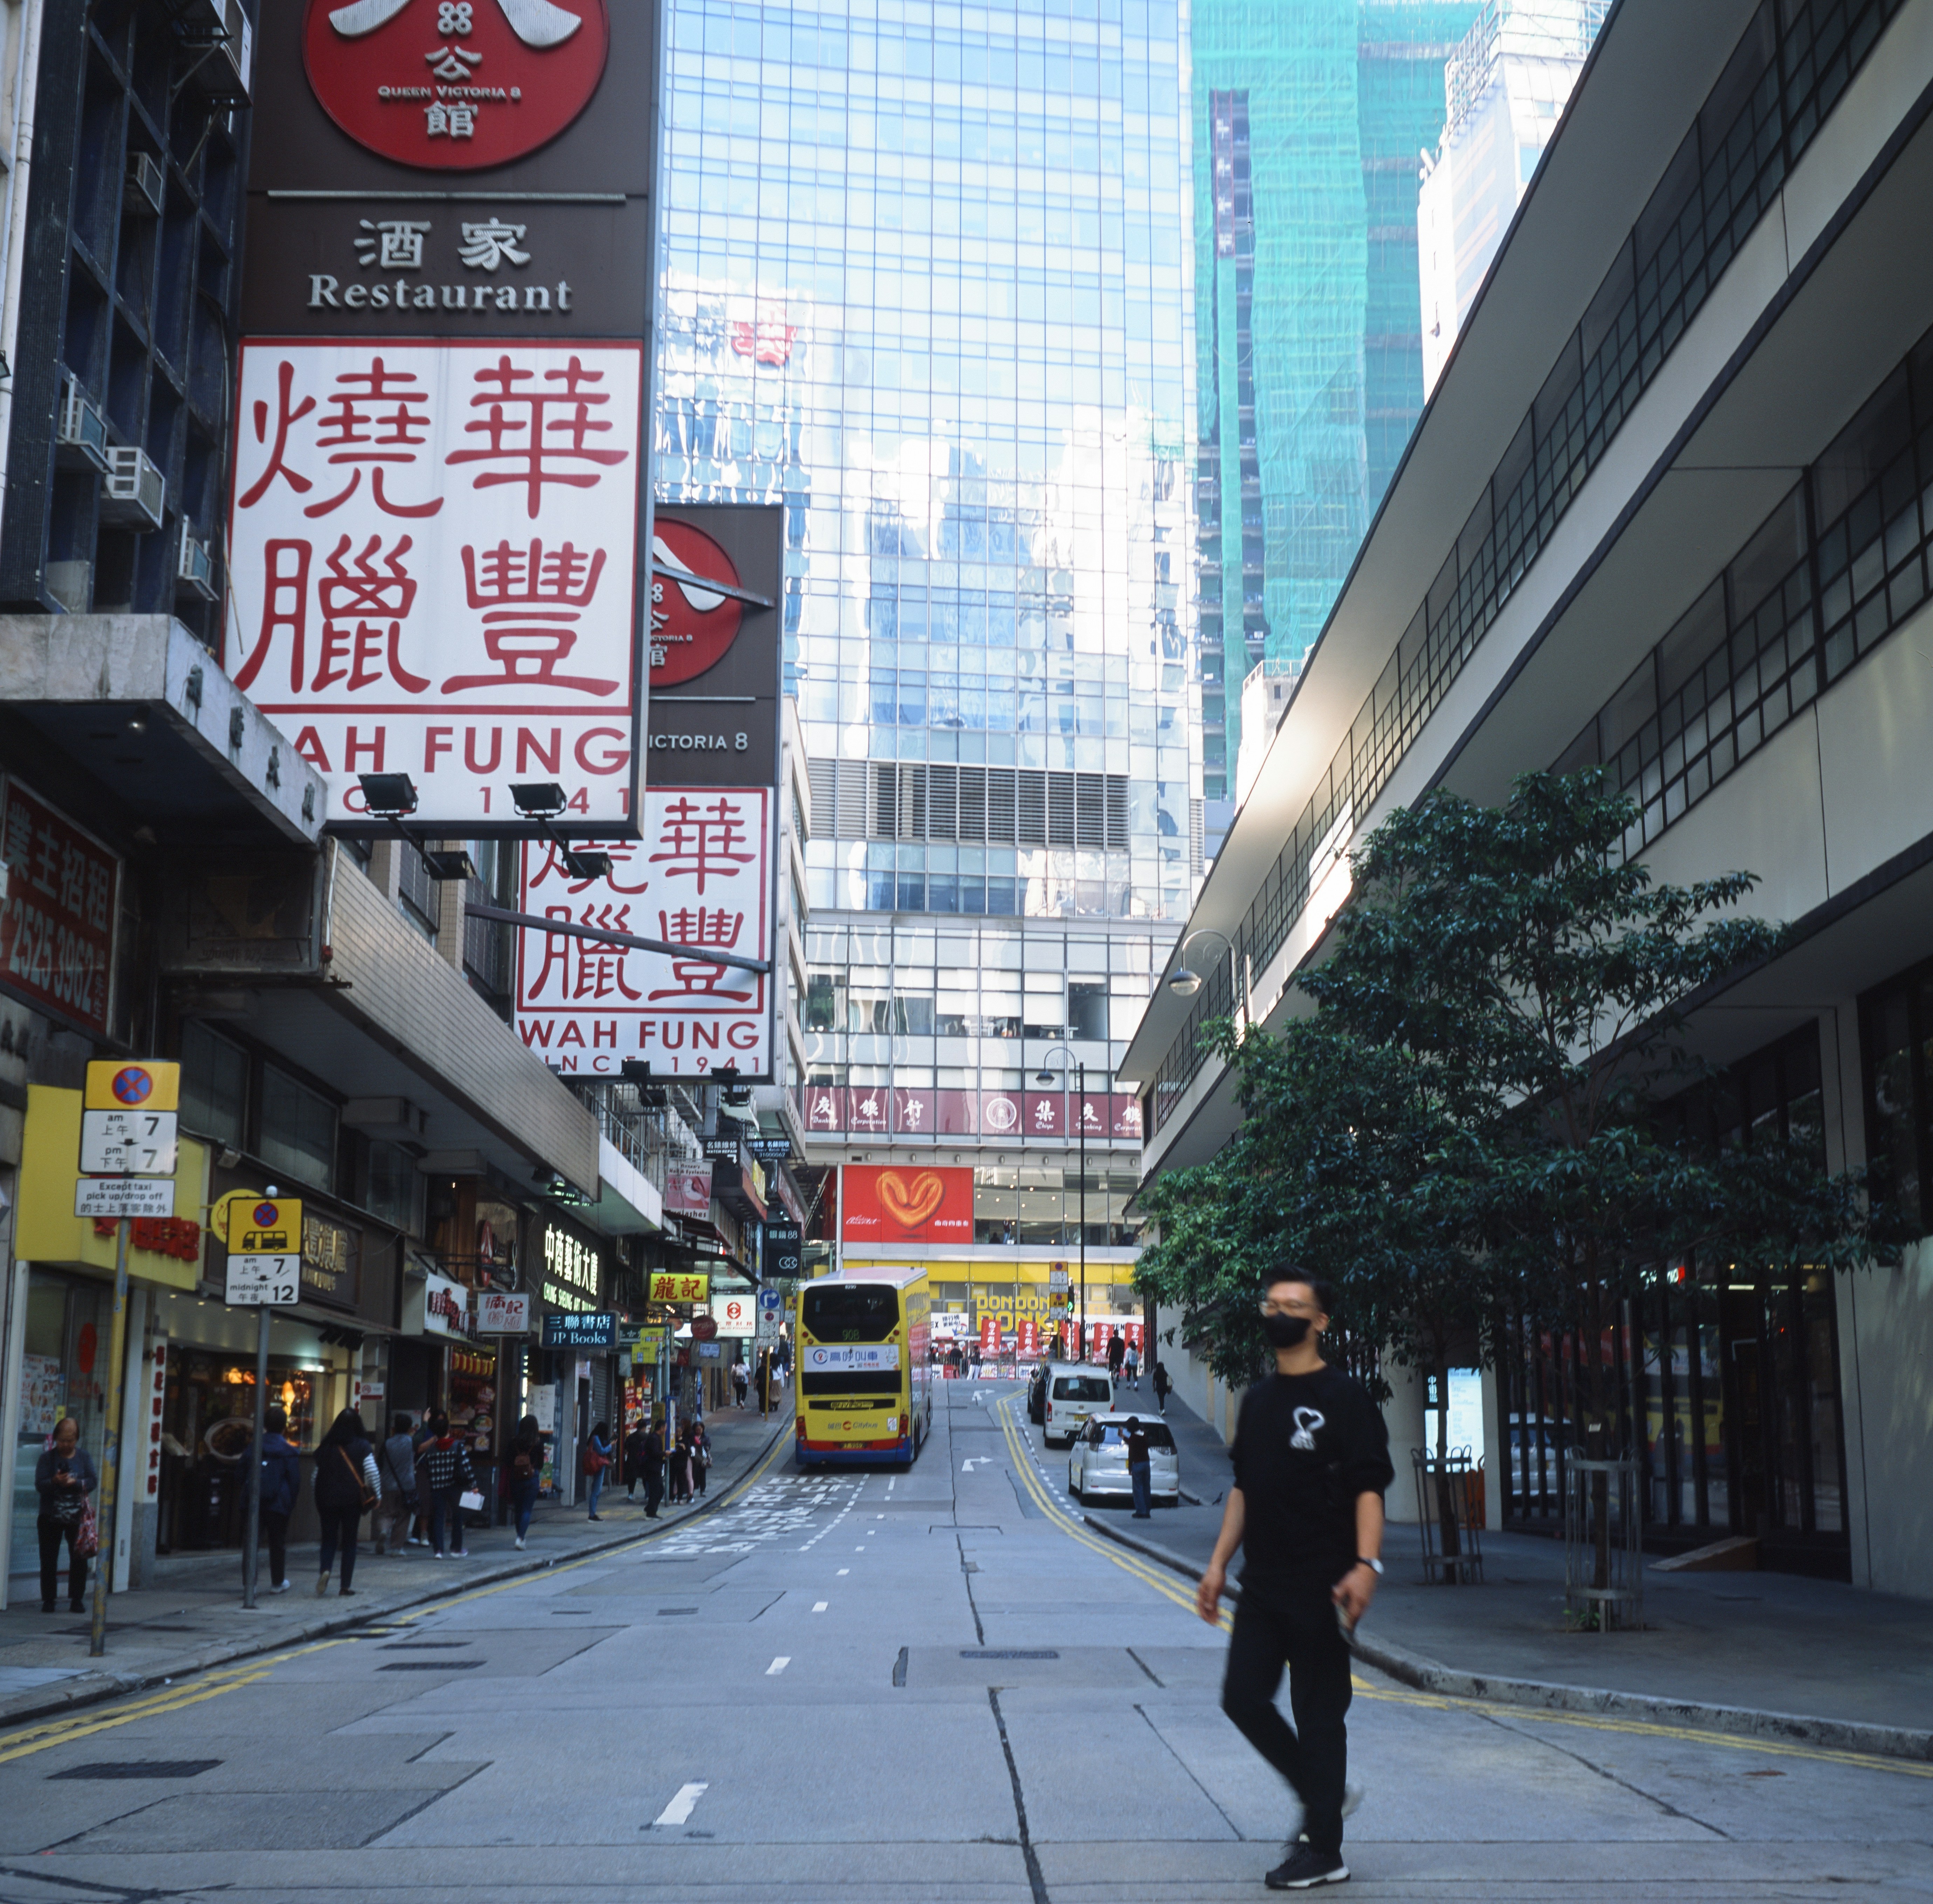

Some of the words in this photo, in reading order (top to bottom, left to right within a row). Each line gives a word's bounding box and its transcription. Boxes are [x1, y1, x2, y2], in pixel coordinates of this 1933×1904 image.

[378, 85, 431, 100] QUEEN
[436, 85, 505, 99] VICTORIA
[510, 87, 522, 100] 8
[424, 101, 478, 138] 館
[354, 217, 531, 271] 酒家
[307, 274, 572, 312] Restaurant
[441, 354, 630, 697] 華豐
[735, 732, 749, 751] 8
[293, 726, 386, 773] AH
[424, 726, 631, 775] FUNG
[479, 786, 628, 815] 141
[7, 801, 109, 933] 業主招租
[648, 796, 756, 1003] 華豐
[9, 897, 54, 991] 2525
[54, 924, 94, 1013] 3962
[518, 1019, 618, 1049] WAH
[639, 1021, 759, 1050] FUNG
[672, 1056, 759, 1074] 1941
[145, 1116, 159, 1136] 7
[812, 1116, 838, 1125] Banking
[851, 1116, 886, 1125] Corporation
[1036, 1121, 1054, 1130] Chiyu
[102, 1124, 128, 1136] 上午
[105, 1147, 122, 1155] pm
[143, 1149, 157, 1168] 7
[101, 1157, 126, 1168] 下午
[99, 1182, 131, 1191] Except
[134, 1182, 152, 1191] taxi
[86, 1192, 105, 1201] pick
[109, 1192, 146, 1200] up/drop
[81, 1203, 167, 1213] 的士上落客除外
[274, 1258, 285, 1274] 7
[545, 1223, 598, 1296] 中商藝術大廈
[240, 1265, 260, 1274] 上午
[273, 1285, 294, 1301] 12
[653, 1276, 703, 1300] 龍記
[239, 1293, 259, 1302] 午夜
[977, 1296, 1012, 1310] DON
[1015, 1296, 1050, 1310] DON
[548, 1314, 611, 1330] 三聯書店
[551, 1332, 566, 1344] JP
[570, 1331, 607, 1344] Books
[842, 1329, 860, 1341] 90B
